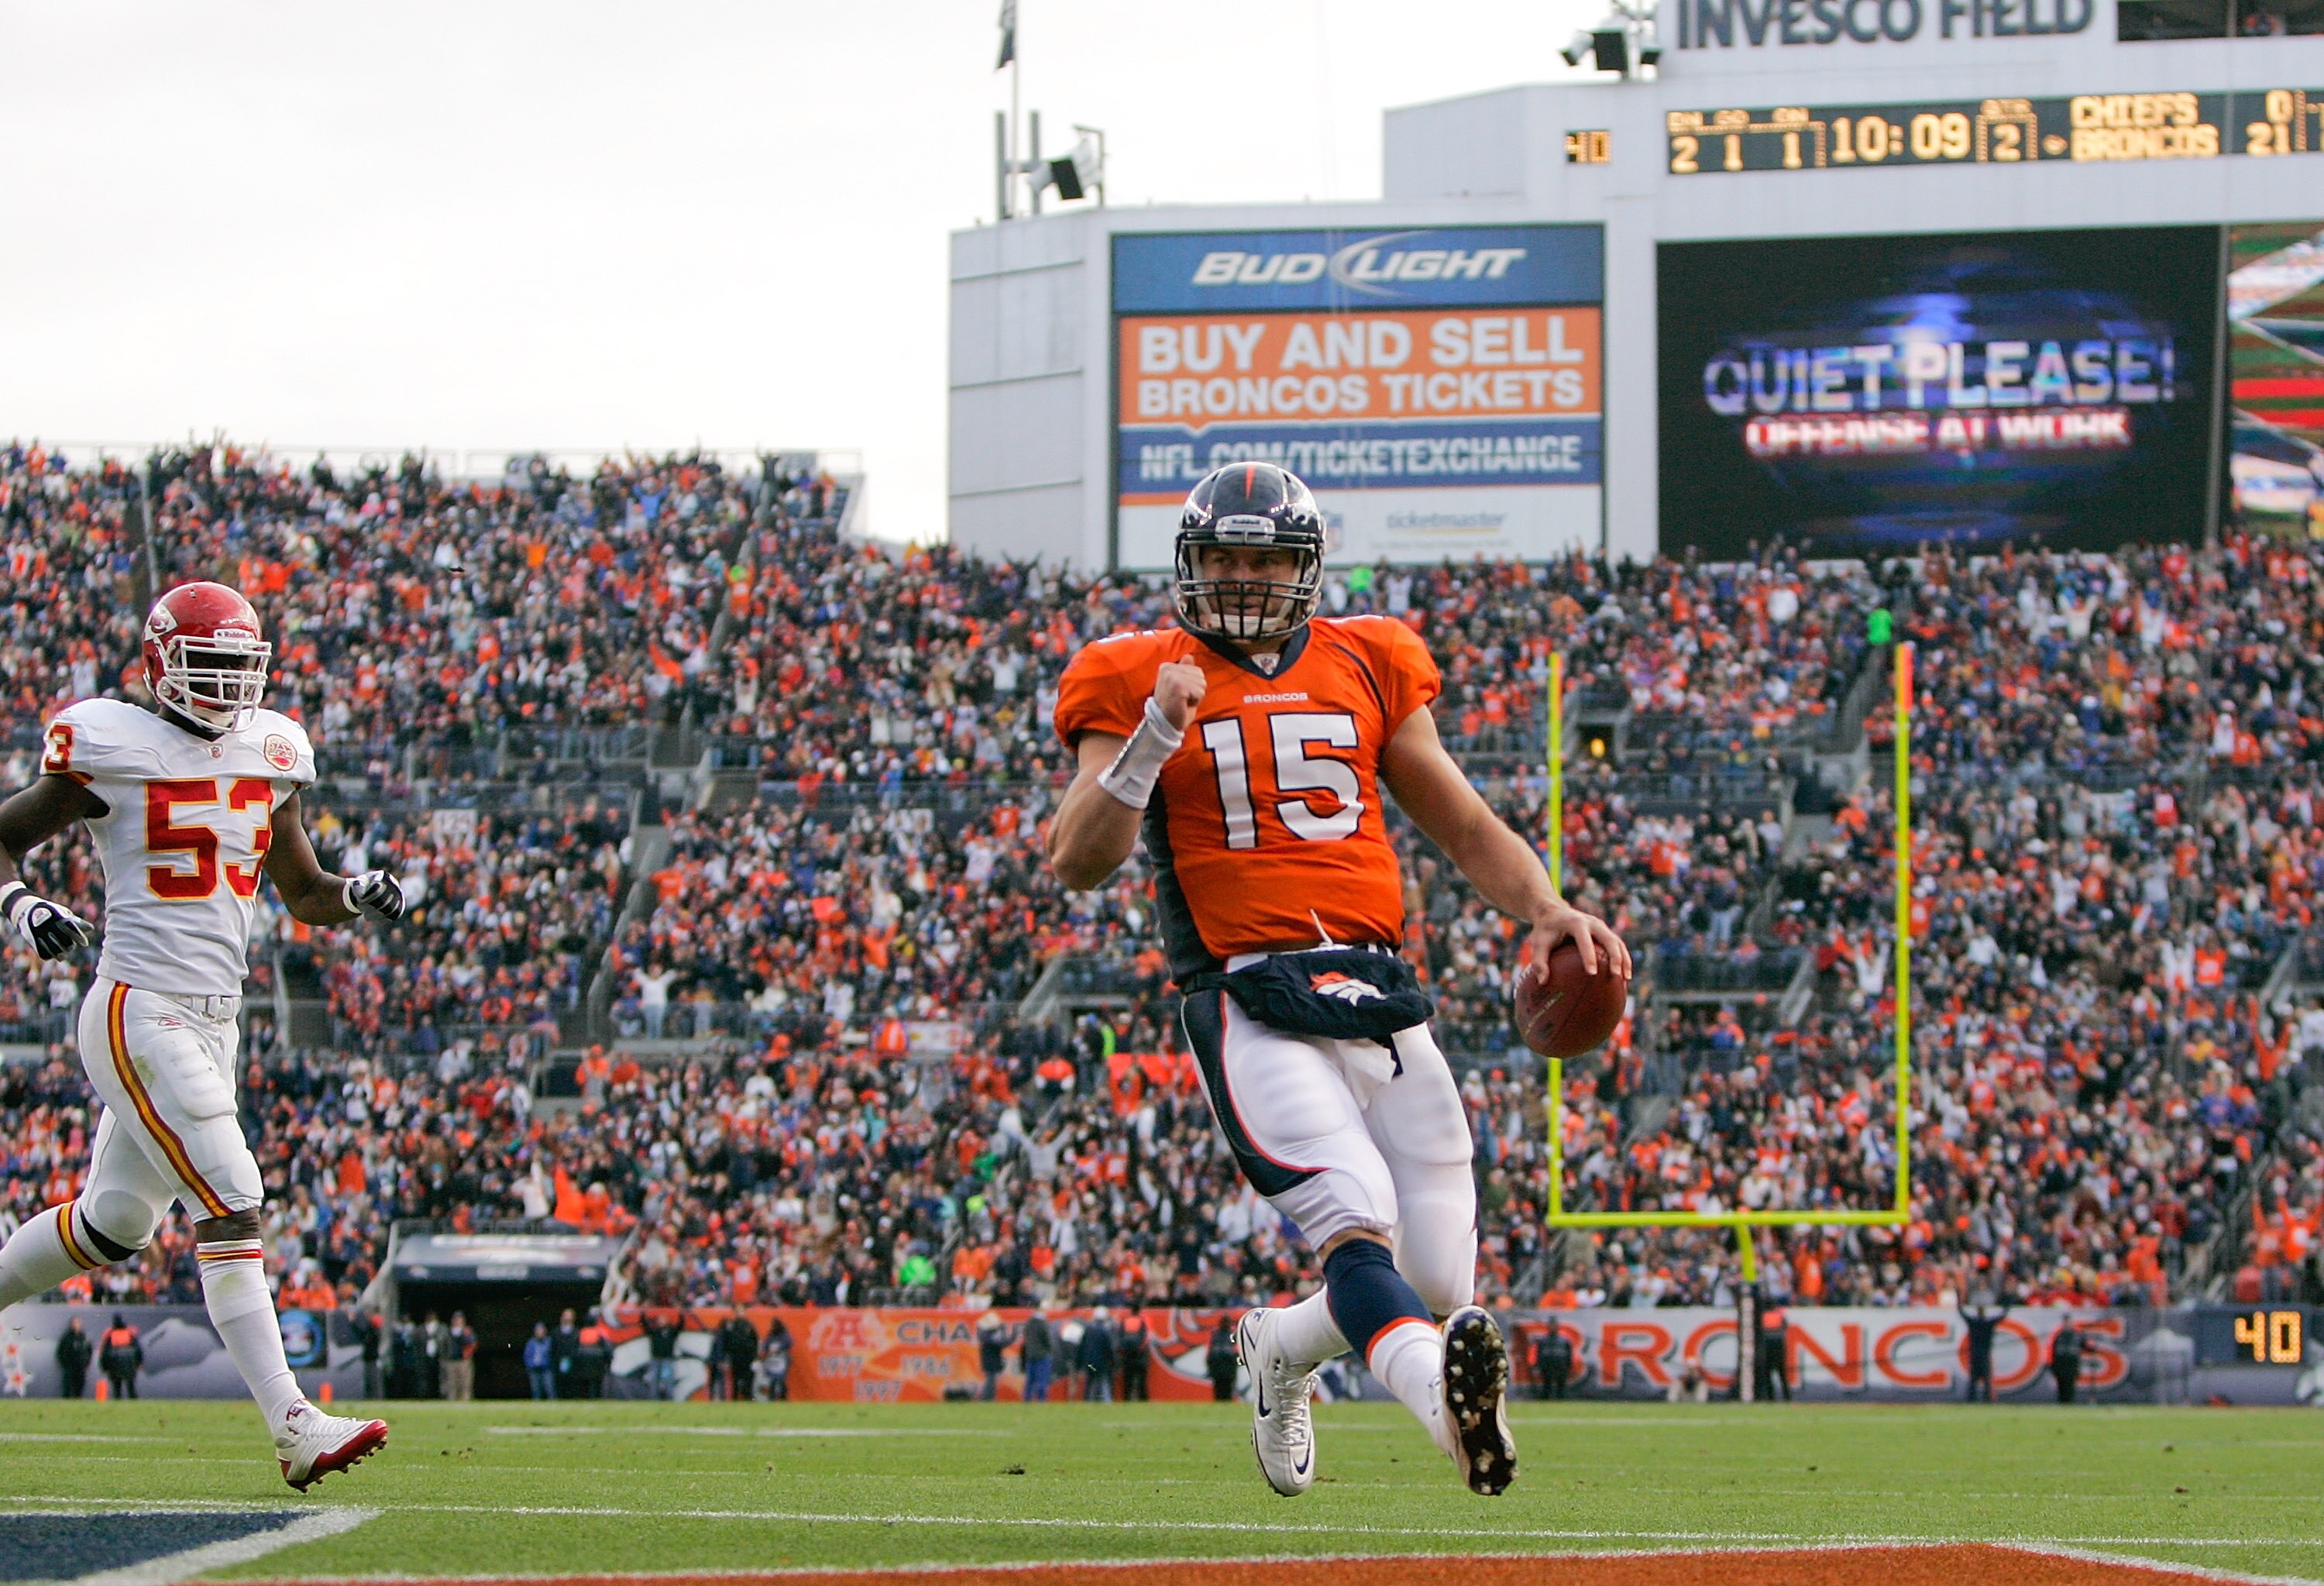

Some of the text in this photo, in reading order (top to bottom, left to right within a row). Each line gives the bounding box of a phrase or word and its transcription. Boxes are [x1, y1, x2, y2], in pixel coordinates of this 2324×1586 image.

[1676, 0, 2093, 49] INVESCO FIELD
[2070, 91, 2199, 129] CHIEFS
[2265, 88, 2295, 124] 0
[1564, 129, 1611, 164] 40
[1671, 130, 1803, 174] 2 1 1
[1831, 112, 1971, 163] 10:09
[1992, 123, 2021, 162] 2
[2070, 122, 2220, 162] BRONCOS
[2245, 121, 2291, 157] 21
[1191, 247, 1528, 285] BUD LIGHT
[1138, 316, 1584, 373] BUY AND SELL
[1138, 369, 1584, 417] BRONCOS TICKETS
[1705, 339, 2175, 415] QUIET PLEASE!
[1745, 412, 1931, 457] OFFENSE
[1996, 406, 2133, 449] WORK
[1243, 692, 1308, 704] BRONCOS
[1202, 713, 1366, 851] 15
[145, 778, 273, 902] 53
[1511, 1319, 2129, 1391] BRONCOS
[2234, 1310, 2302, 1363] 40
